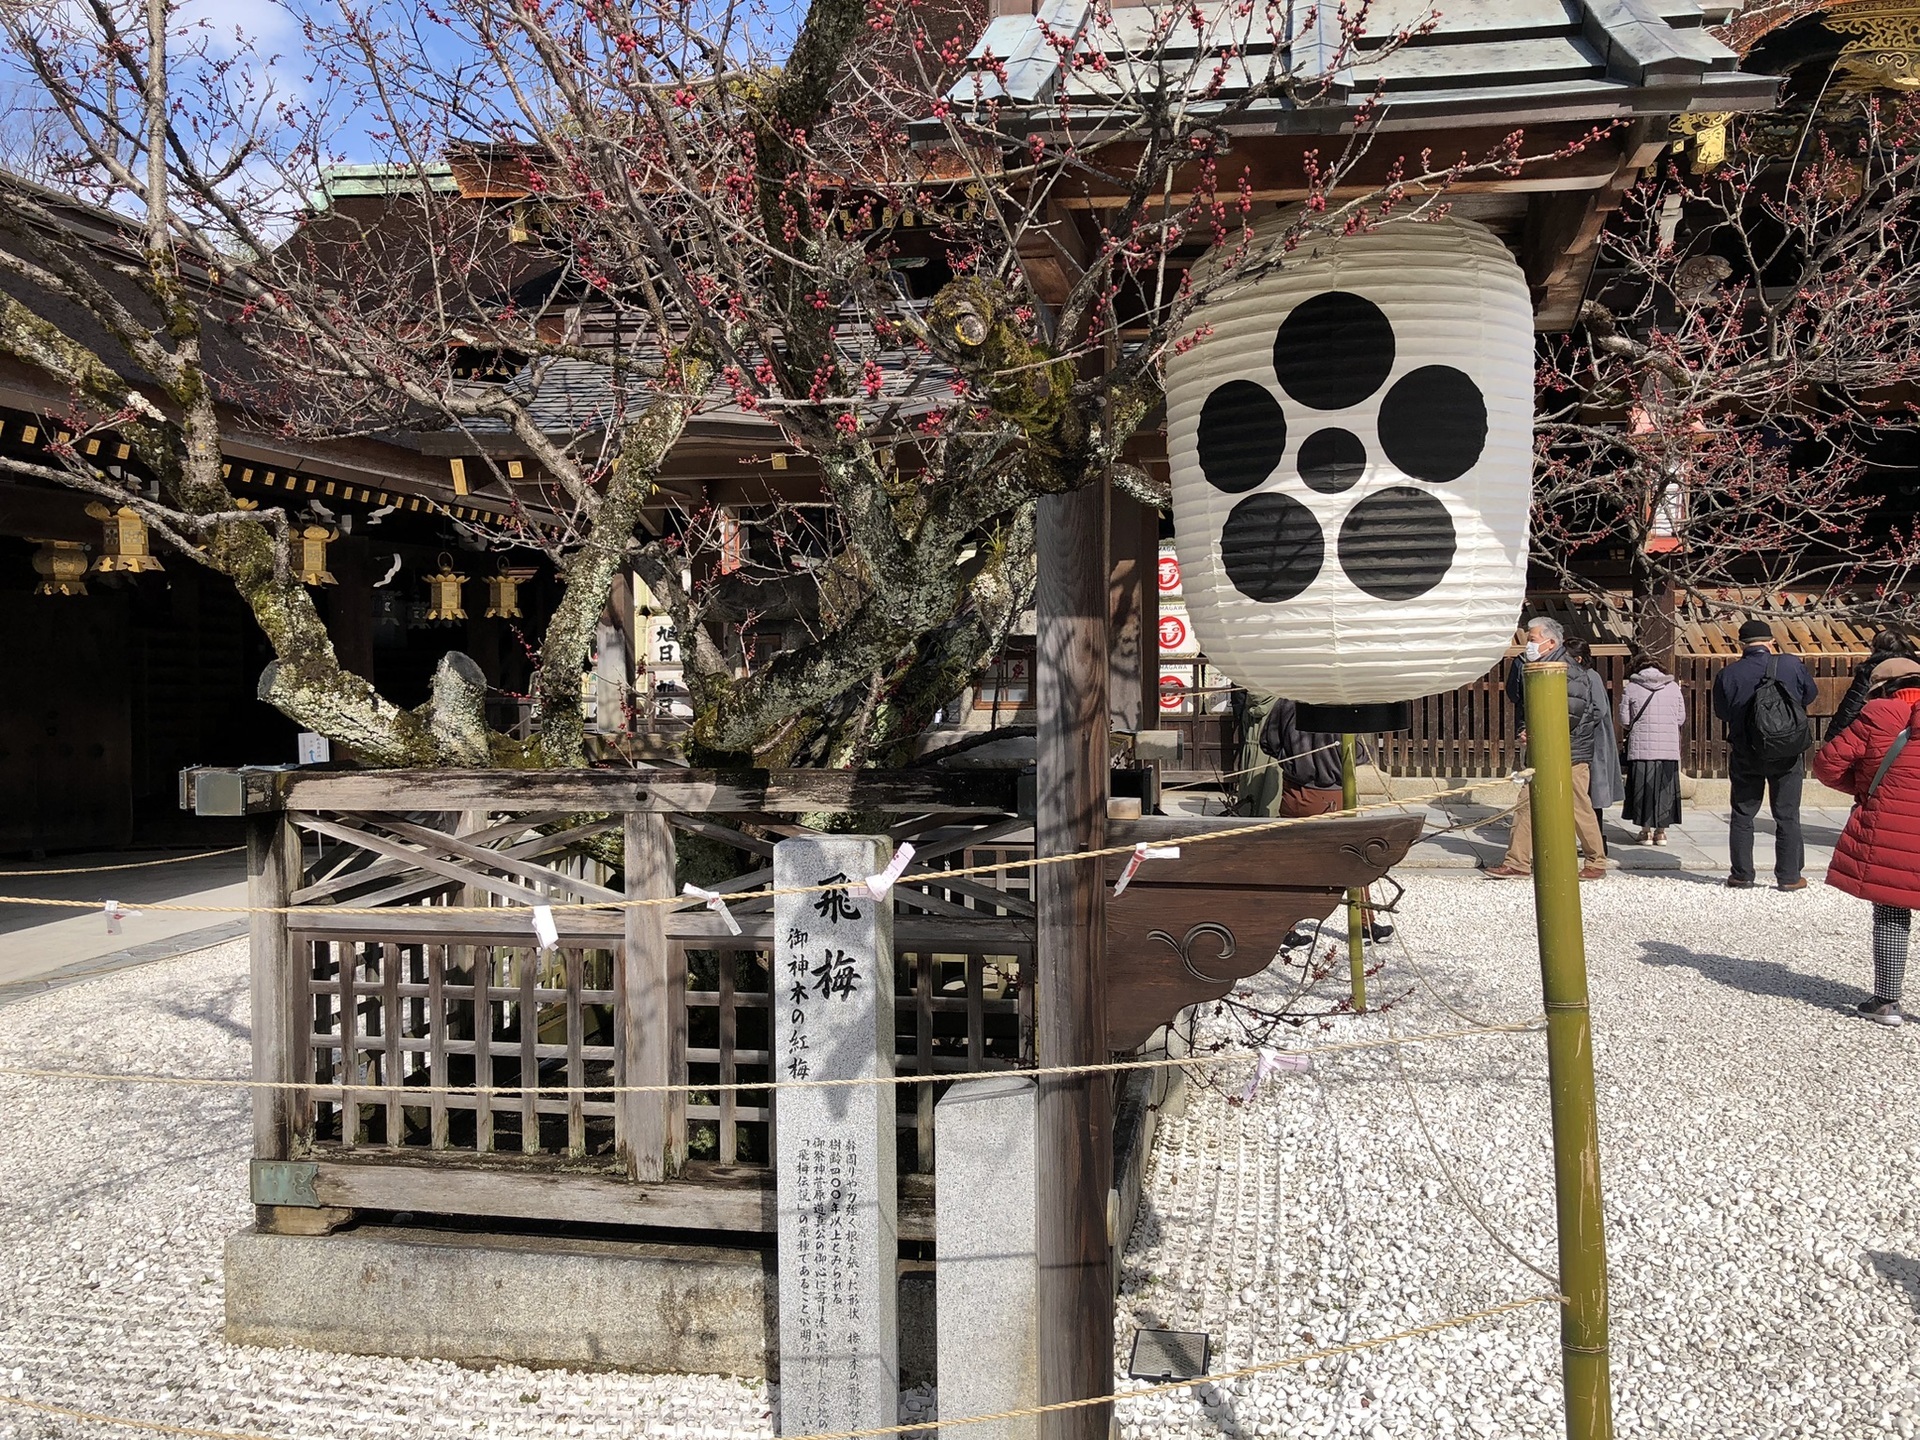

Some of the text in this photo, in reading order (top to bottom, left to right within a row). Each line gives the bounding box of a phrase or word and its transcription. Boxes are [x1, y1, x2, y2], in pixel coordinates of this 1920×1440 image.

[656, 625, 678, 661] 旭日
[811, 872, 862, 1002] 飛梅
[786, 927, 811, 1080] 御神木の紅梅
